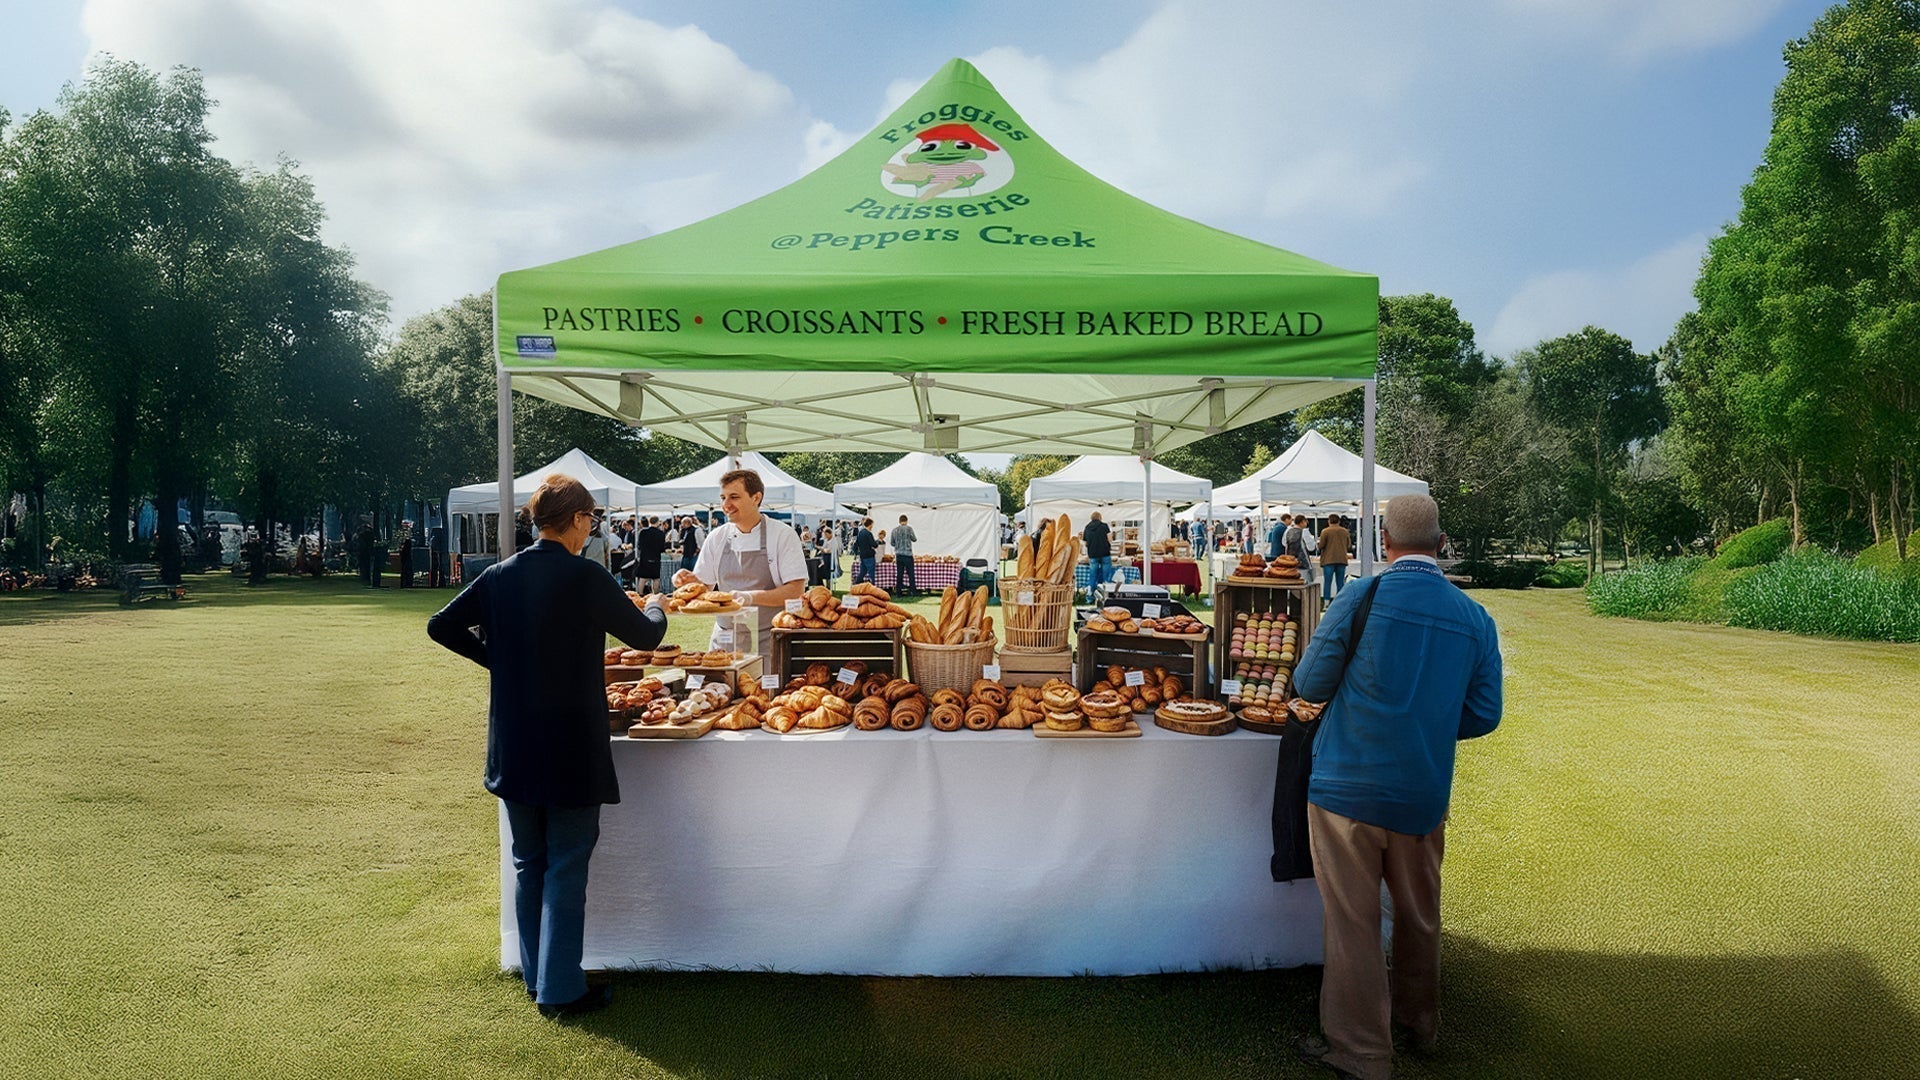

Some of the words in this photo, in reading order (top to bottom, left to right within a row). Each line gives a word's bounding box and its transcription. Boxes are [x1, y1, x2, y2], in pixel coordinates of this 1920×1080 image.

[879, 102, 1029, 145] Froggies
[845, 191, 1031, 220] Patisserie
[978, 225, 1097, 248] Creek
[541, 307, 682, 333] PASTRIES
[721, 308, 925, 335] CROISSANTS
[960, 310, 1066, 336] FRESH
[1075, 310, 1194, 337] BAKED
[1203, 311, 1324, 338] BREAD
